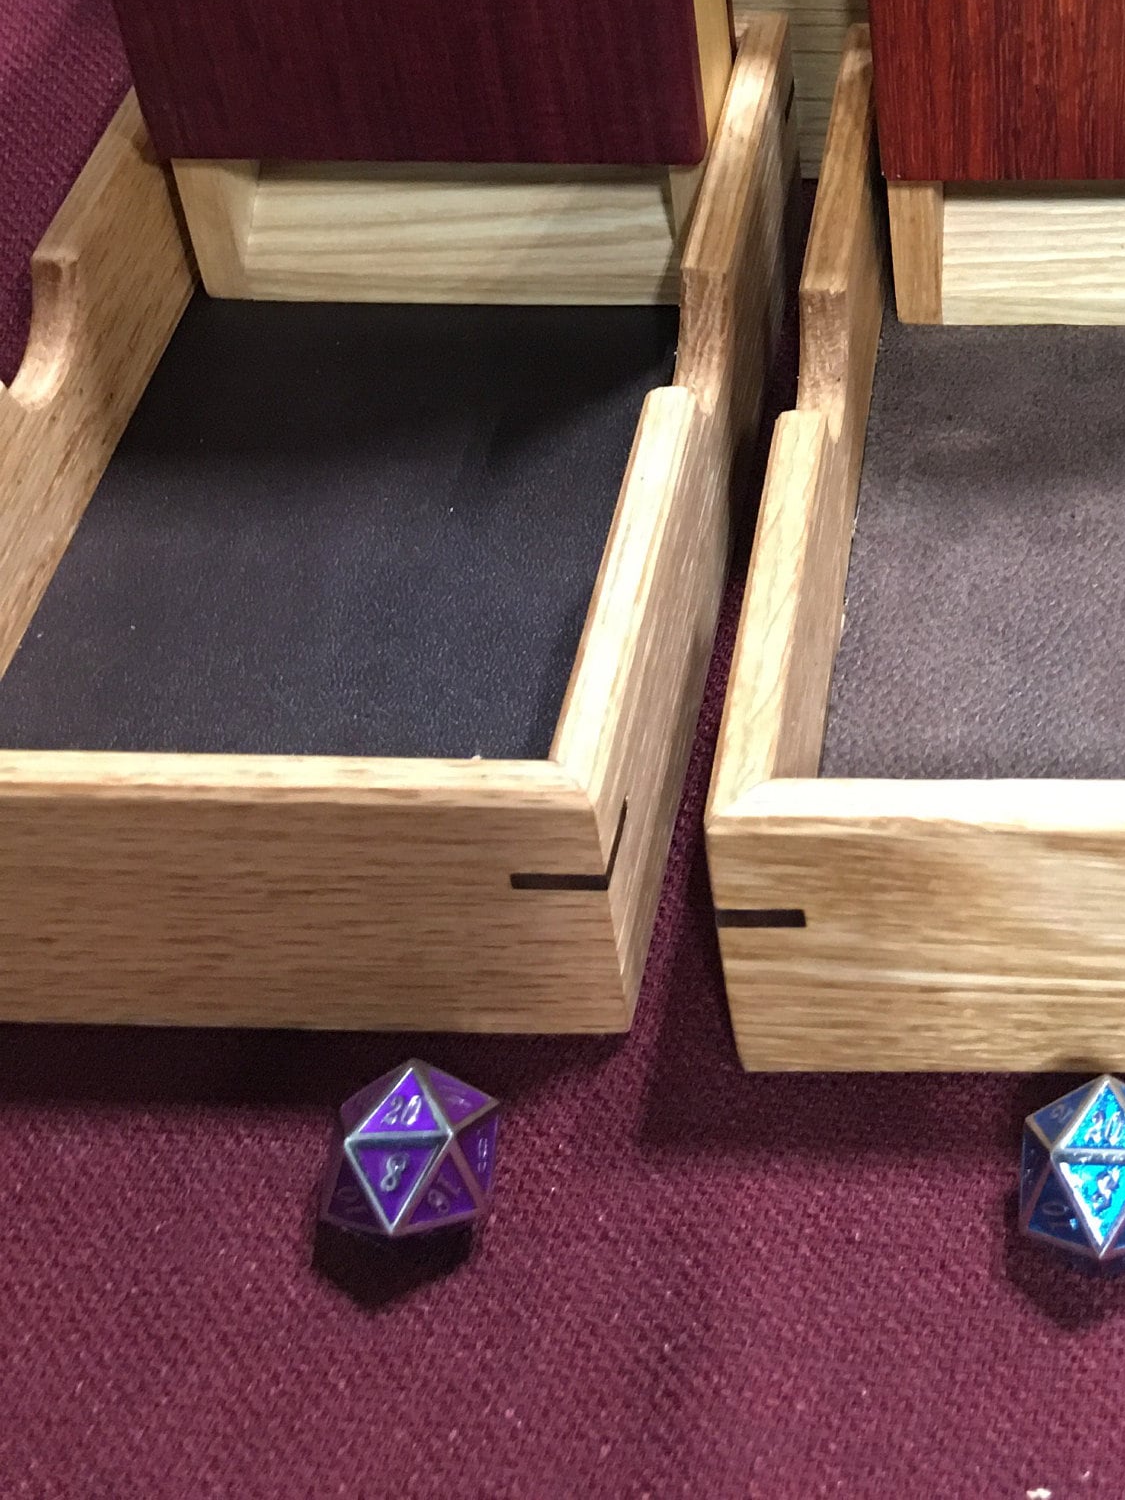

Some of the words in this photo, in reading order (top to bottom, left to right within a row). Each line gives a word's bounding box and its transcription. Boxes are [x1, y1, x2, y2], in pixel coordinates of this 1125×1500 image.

[381, 1094, 422, 1126] 20
[1084, 1111, 1125, 1145] 20
[380, 1152, 409, 1193] 8
